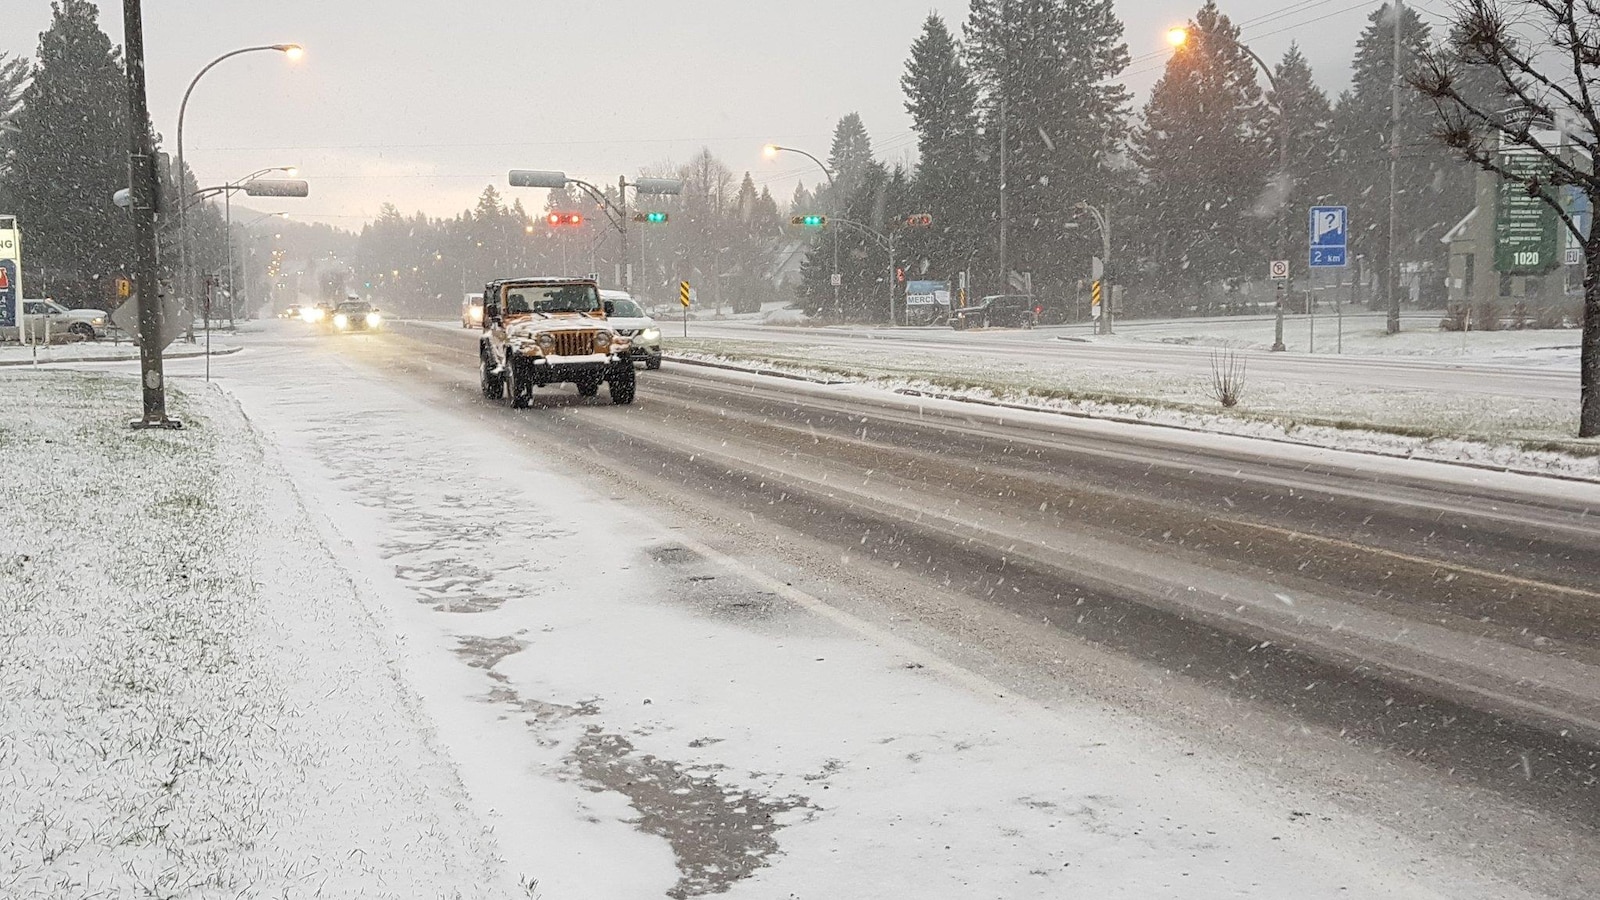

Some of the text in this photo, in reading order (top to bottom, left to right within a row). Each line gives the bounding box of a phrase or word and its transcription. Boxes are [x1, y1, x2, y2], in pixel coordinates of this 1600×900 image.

[1314, 250, 1341, 262] 2 km
[1513, 251, 1539, 265] 1020
